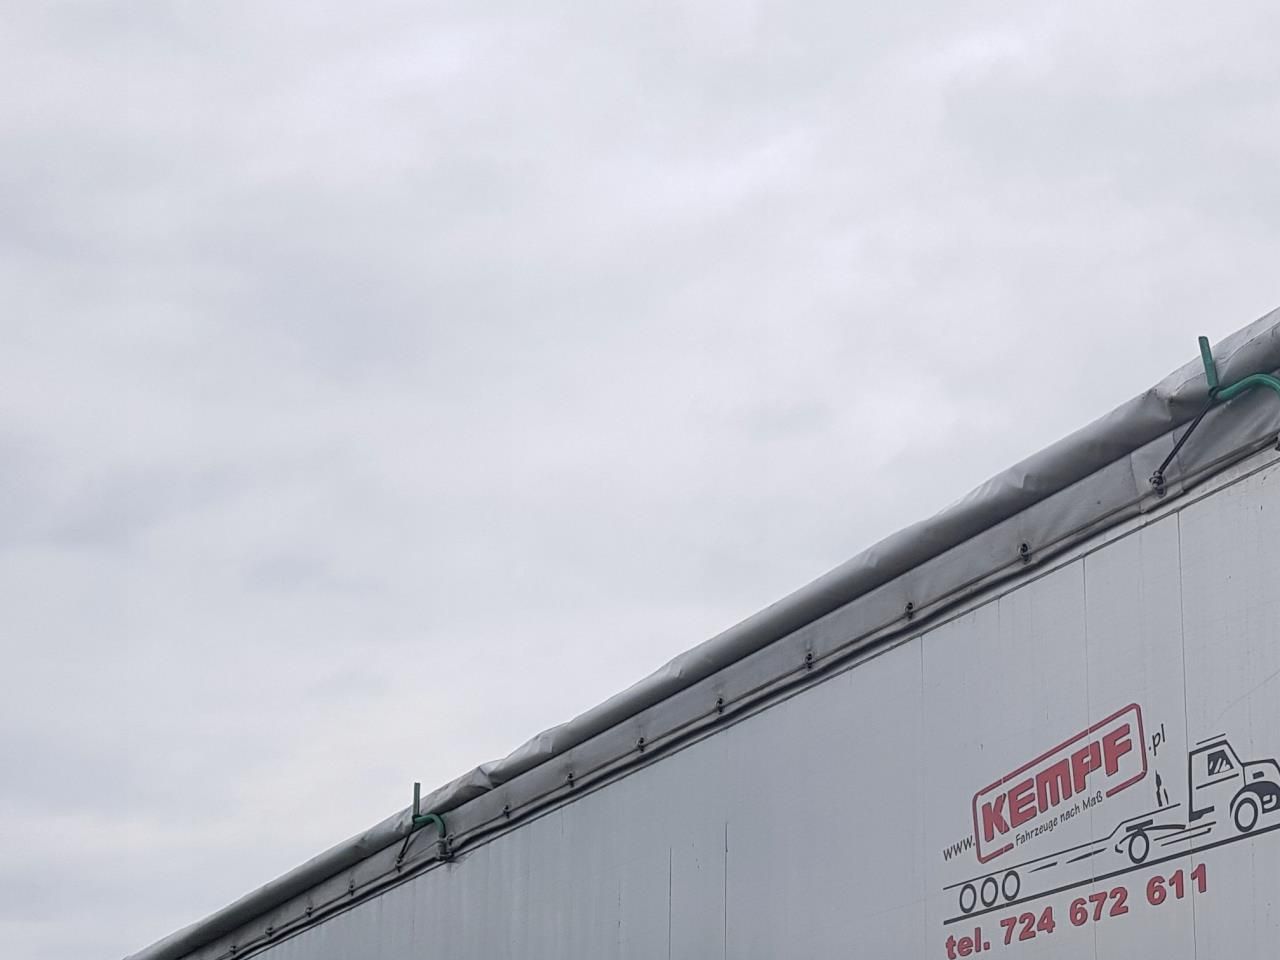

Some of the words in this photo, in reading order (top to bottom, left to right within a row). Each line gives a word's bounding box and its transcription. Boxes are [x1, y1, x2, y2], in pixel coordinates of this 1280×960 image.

[943, 835, 976, 862] www.
[981, 723, 1132, 842] KEMPF
[1015, 815, 1058, 847] Fahrzeuge
[1060, 803, 1081, 823] nach
[1082, 790, 1103, 811] Maß
[945, 927, 991, 960] tel.
[1000, 906, 1056, 946] 724
[1069, 886, 1129, 927] 672
[1145, 863, 1207, 906] 611
